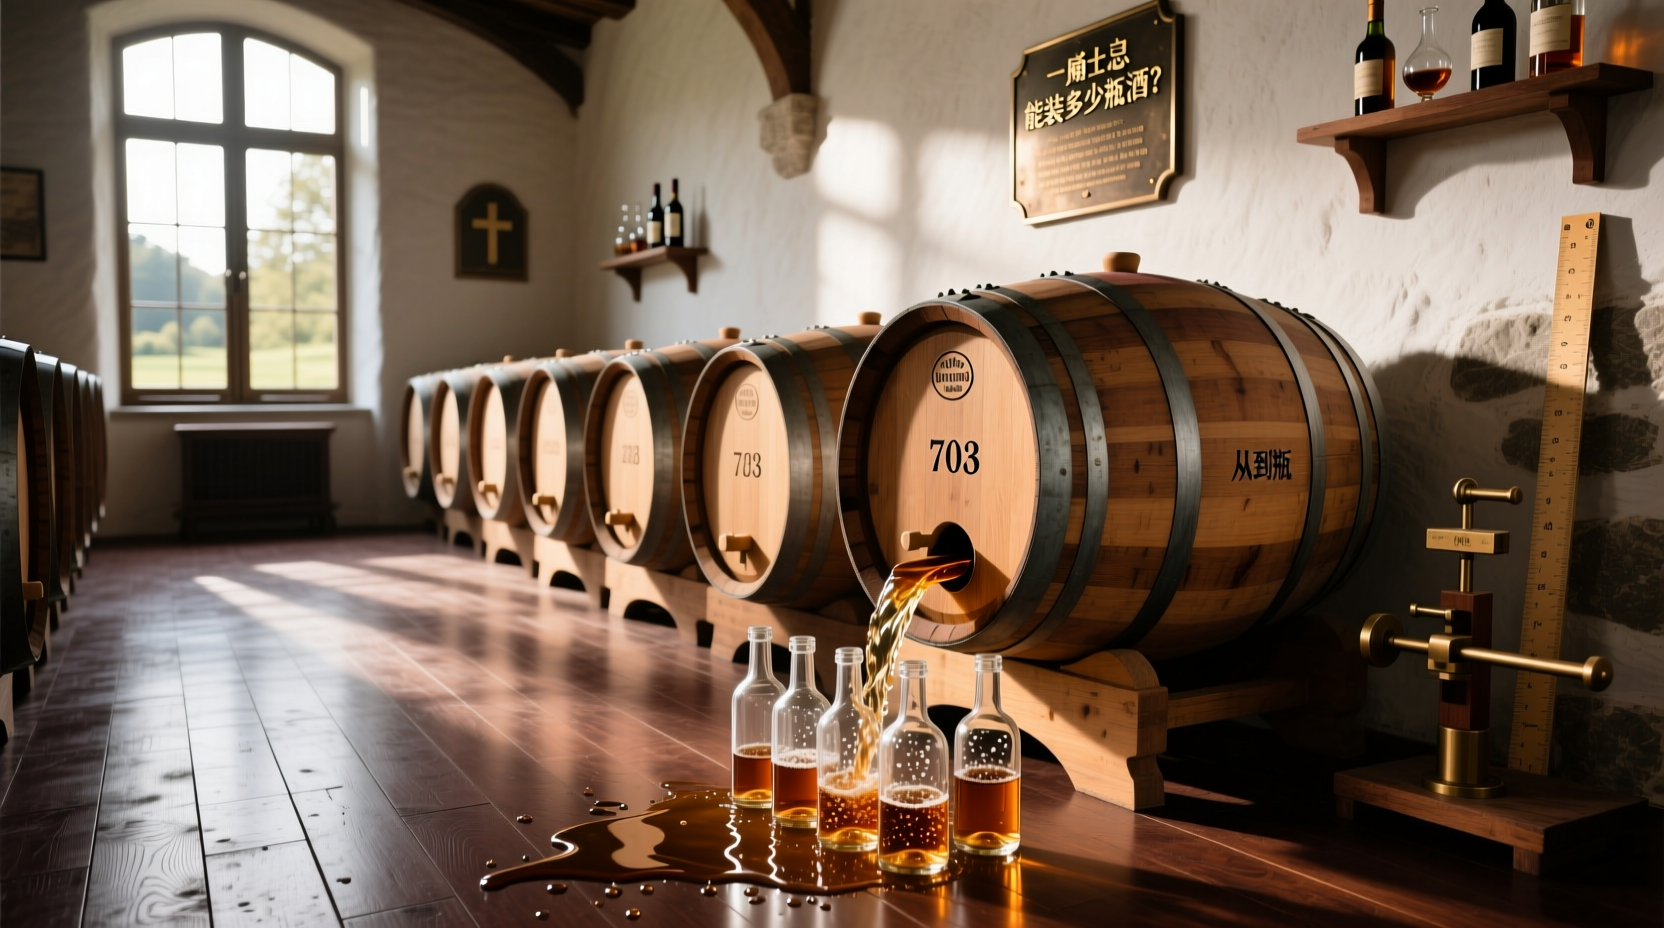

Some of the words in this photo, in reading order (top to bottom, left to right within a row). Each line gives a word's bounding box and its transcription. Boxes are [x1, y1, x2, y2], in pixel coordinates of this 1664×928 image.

[1024, 65, 1162, 131] 能装多少瓶酒?
[930, 439, 980, 475] 703
